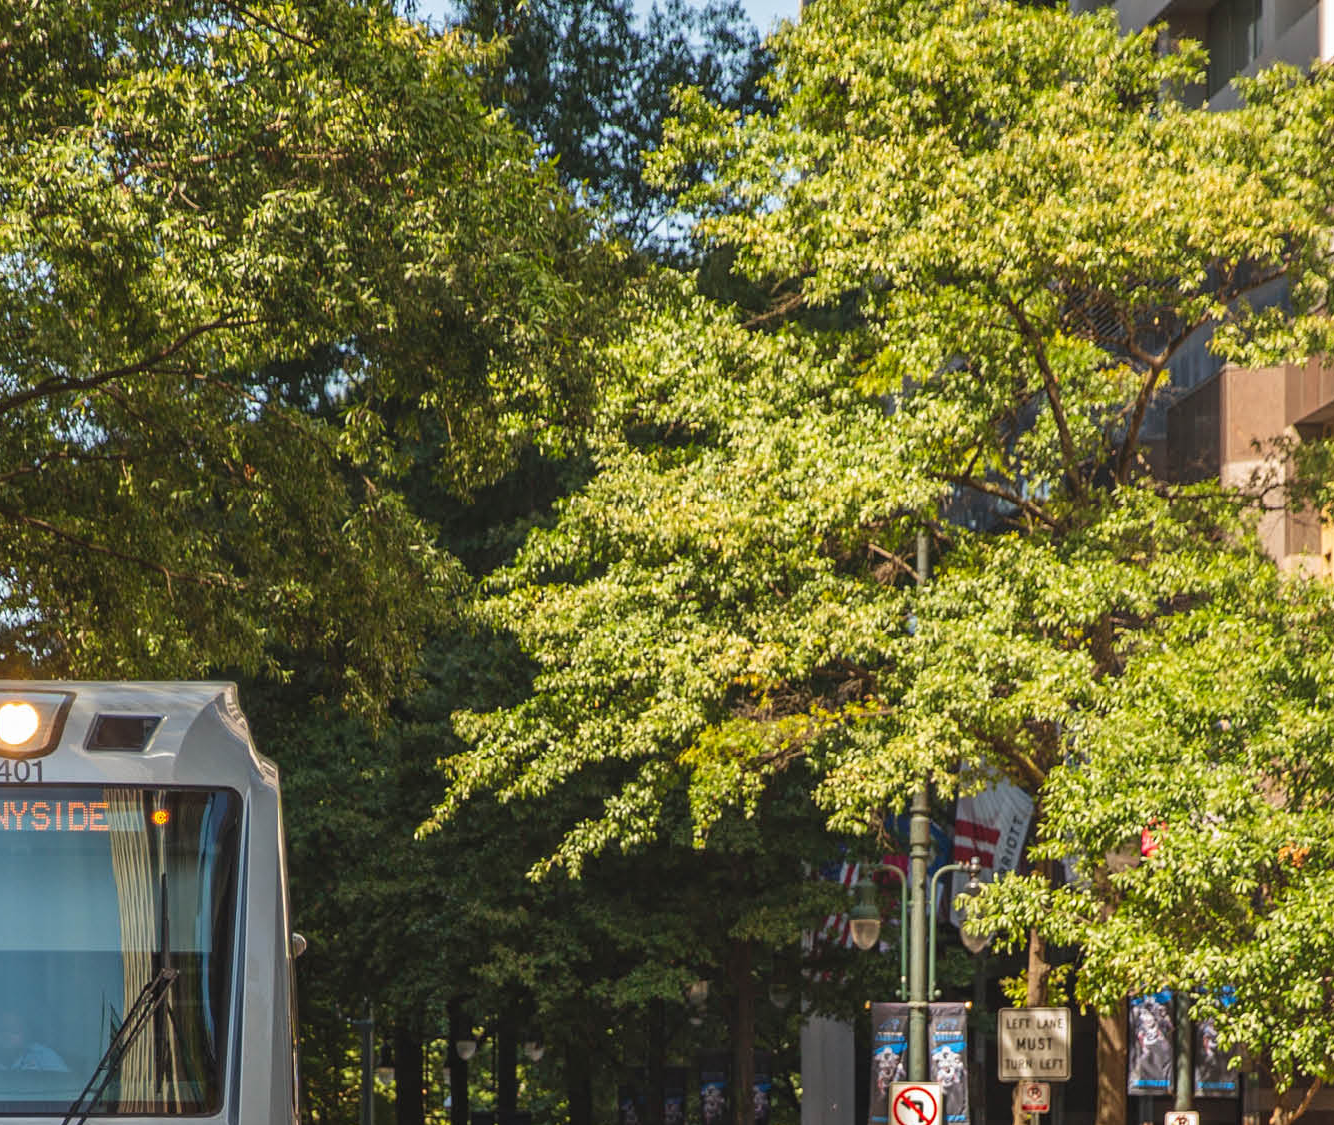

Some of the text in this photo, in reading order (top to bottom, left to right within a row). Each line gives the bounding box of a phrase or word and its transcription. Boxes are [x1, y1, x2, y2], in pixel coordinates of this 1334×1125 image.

[1006, 1018, 1064, 1029] LEFT LANE
[1017, 1037, 1052, 1050] MUST
[1006, 1058, 1063, 1070] TURN LEFT
